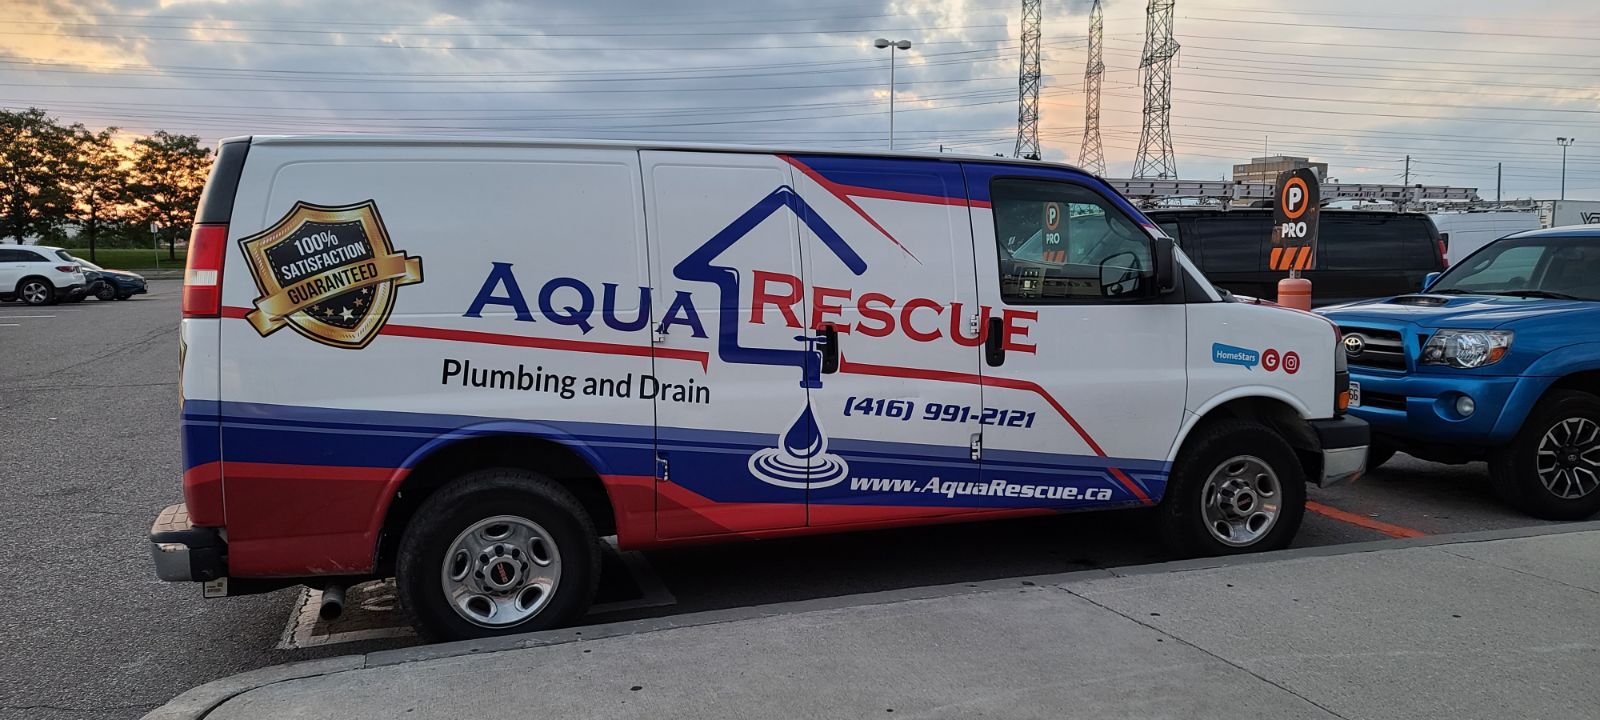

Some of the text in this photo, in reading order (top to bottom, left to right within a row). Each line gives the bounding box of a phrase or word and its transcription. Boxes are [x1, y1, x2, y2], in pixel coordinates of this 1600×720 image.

[1288, 187, 1302, 211] P
[1049, 207, 1057, 225] P
[1045, 232, 1060, 245] PRO
[1281, 221, 1307, 238] PRO
[293, 229, 339, 257] 100%
[280, 240, 367, 281] SATISFACTION
[286, 261, 379, 306] GUARANTEED
[461, 261, 1039, 355] AQUA RESCUE
[1216, 349, 1257, 363] HomeStars
[441, 358, 711, 404] Plumbing and Drain
[843, 396, 1036, 429] (416) 991-2121
[849, 476, 1113, 501] www.AquaRescue.ca
